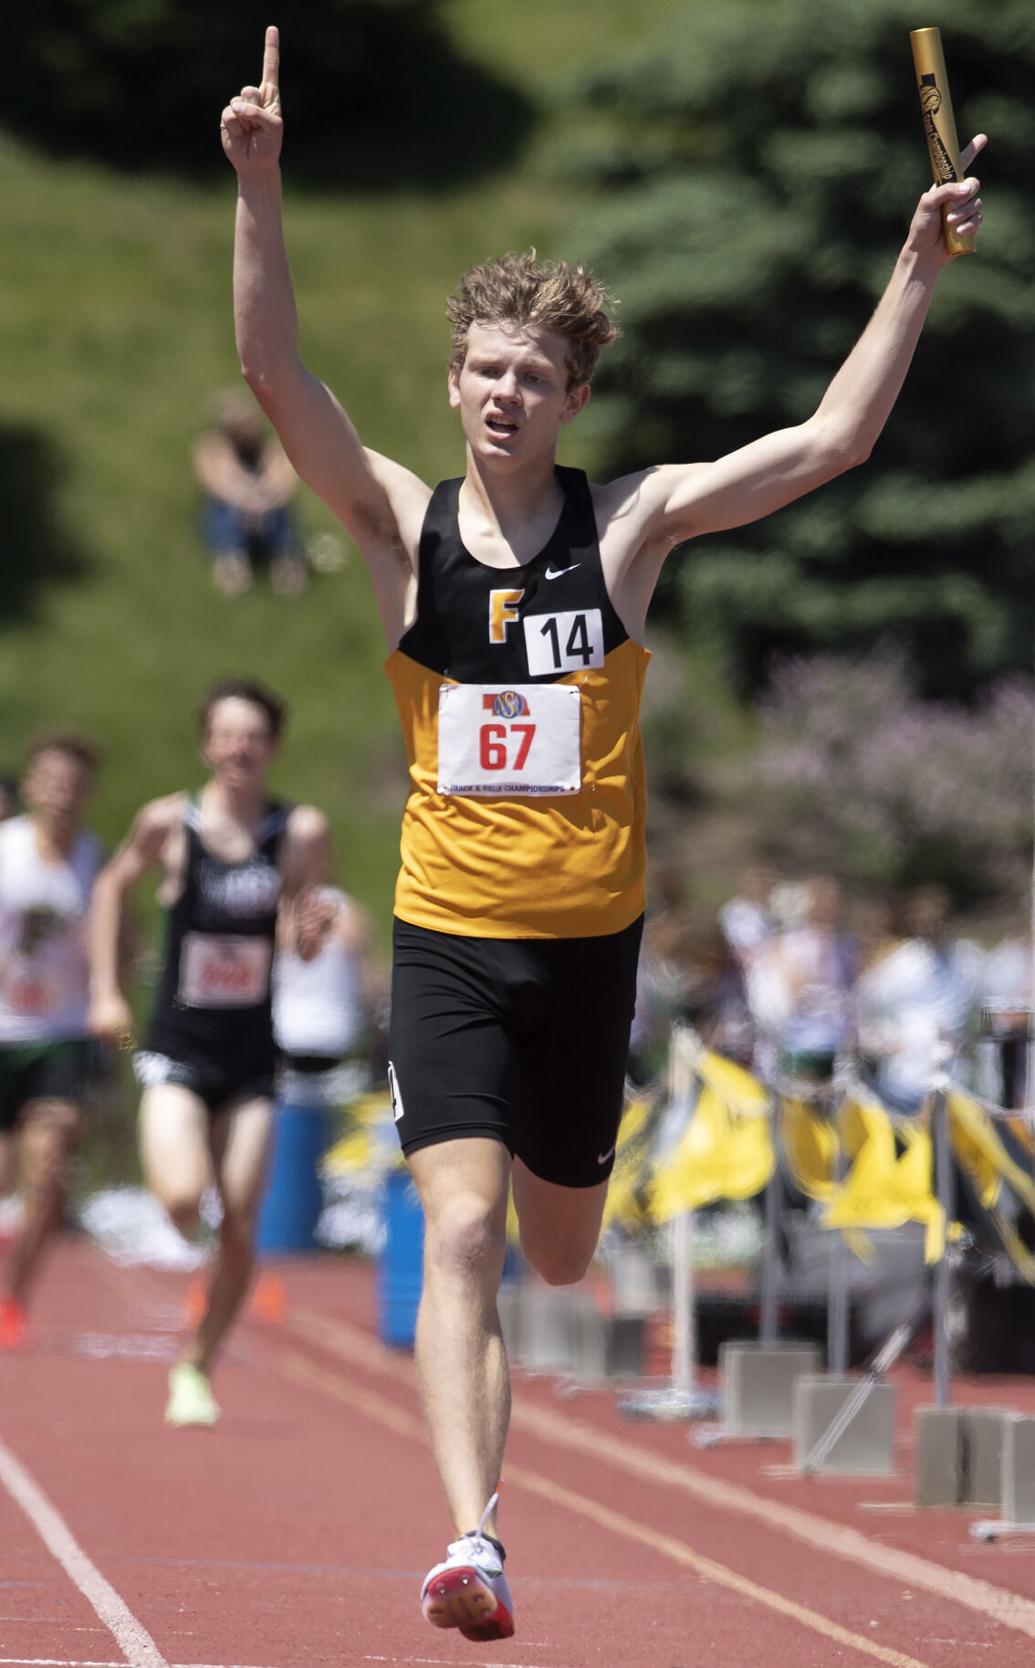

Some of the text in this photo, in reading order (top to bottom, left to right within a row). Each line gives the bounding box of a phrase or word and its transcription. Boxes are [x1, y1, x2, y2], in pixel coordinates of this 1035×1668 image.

[489, 588, 525, 644] F
[540, 614, 594, 668] 14
[479, 723, 536, 771] 67
[504, 784, 566, 793] CHAMPIONSHIPS
